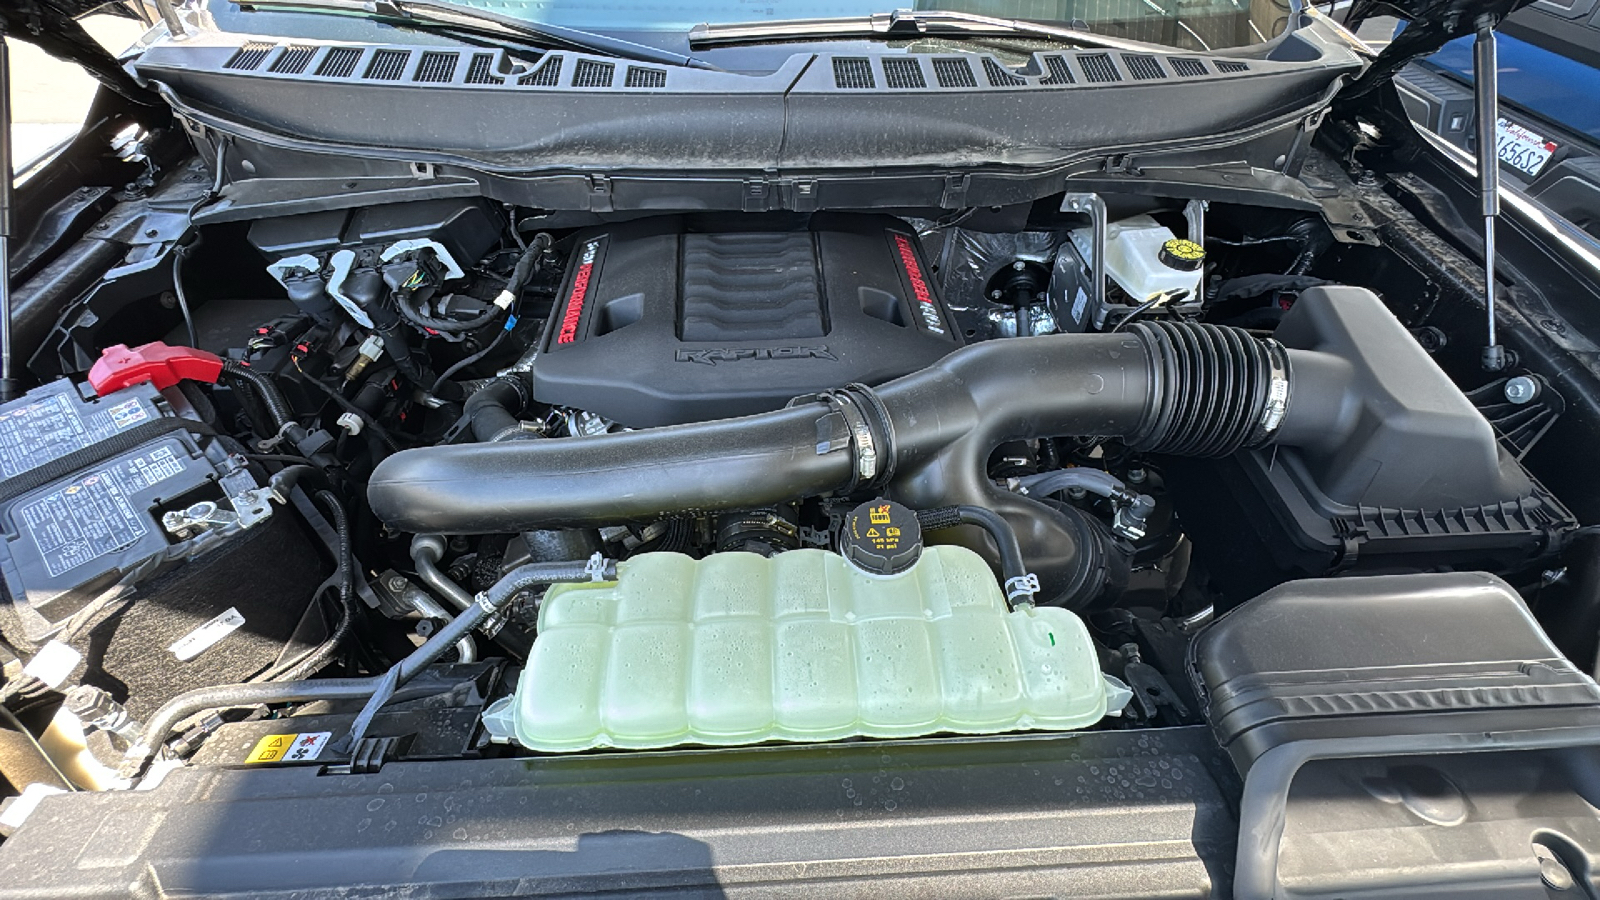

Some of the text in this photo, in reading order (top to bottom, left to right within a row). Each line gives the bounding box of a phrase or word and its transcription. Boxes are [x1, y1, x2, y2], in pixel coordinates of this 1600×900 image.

[1506, 123, 1543, 149] California
[894, 233, 932, 303] PERFORMANCE
[557, 263, 594, 344] PERFORMANCE
[674, 344, 839, 367] RAPTOR
